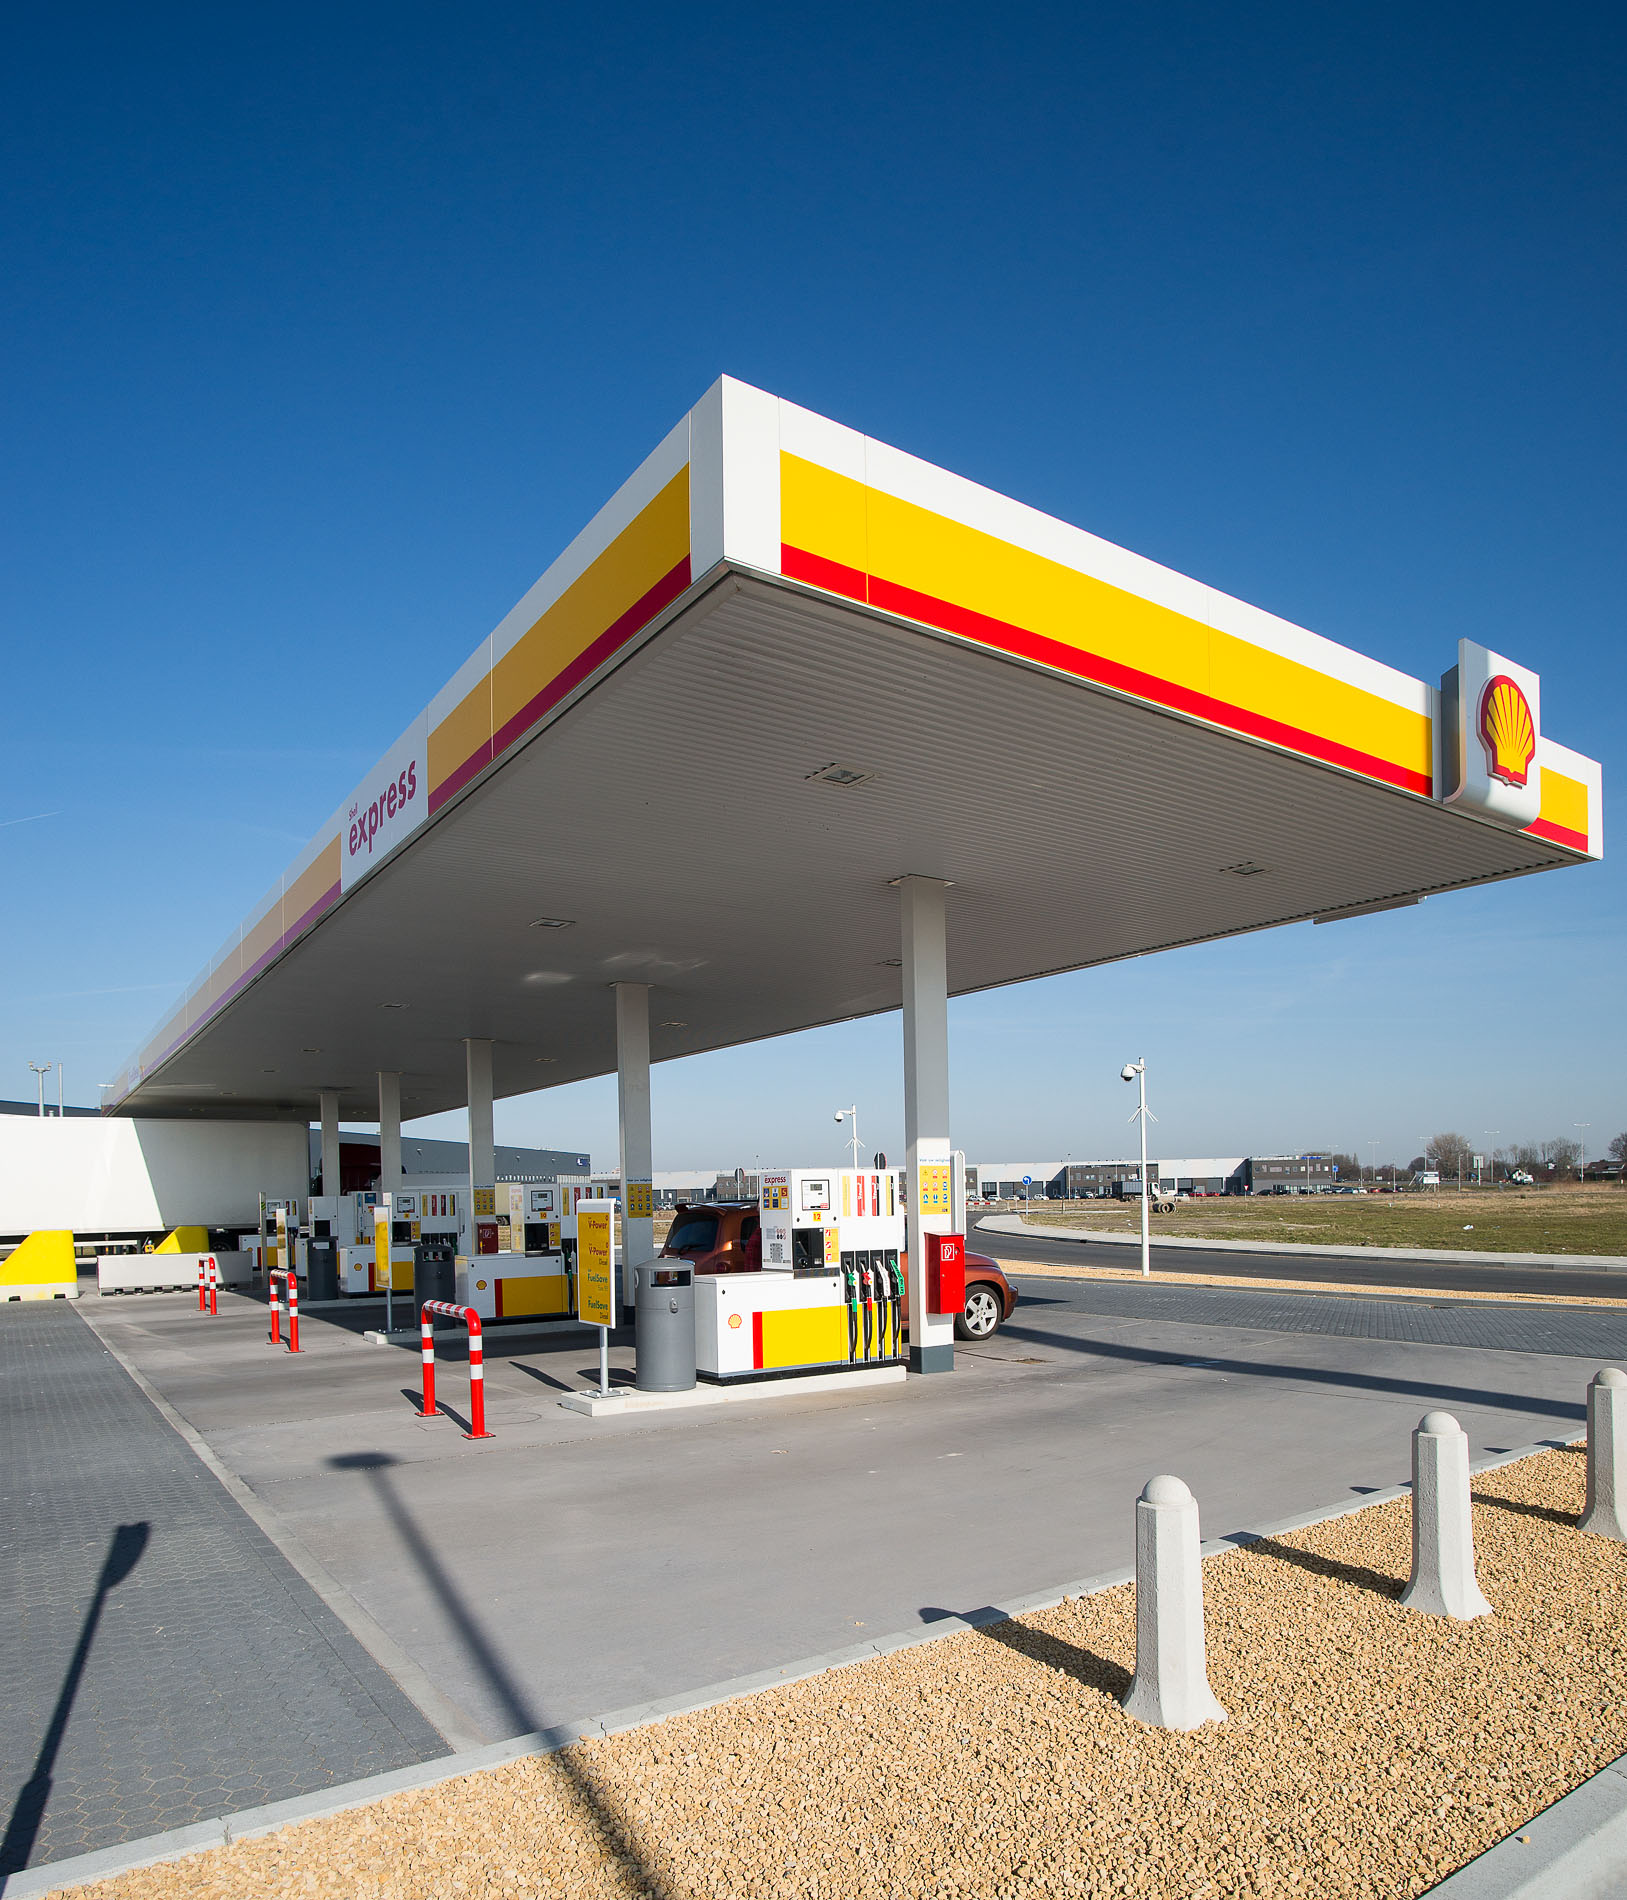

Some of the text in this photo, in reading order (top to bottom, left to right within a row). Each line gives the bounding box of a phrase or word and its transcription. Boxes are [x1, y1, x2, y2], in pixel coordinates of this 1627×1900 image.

[349, 760, 417, 856] express
[764, 1176, 787, 1186] express
[588, 1220, 608, 1230] V-Power
[588, 1246, 608, 1257] V-Power
[587, 1273, 608, 1284] FuelSave
[588, 1300, 608, 1311] FuelSave
